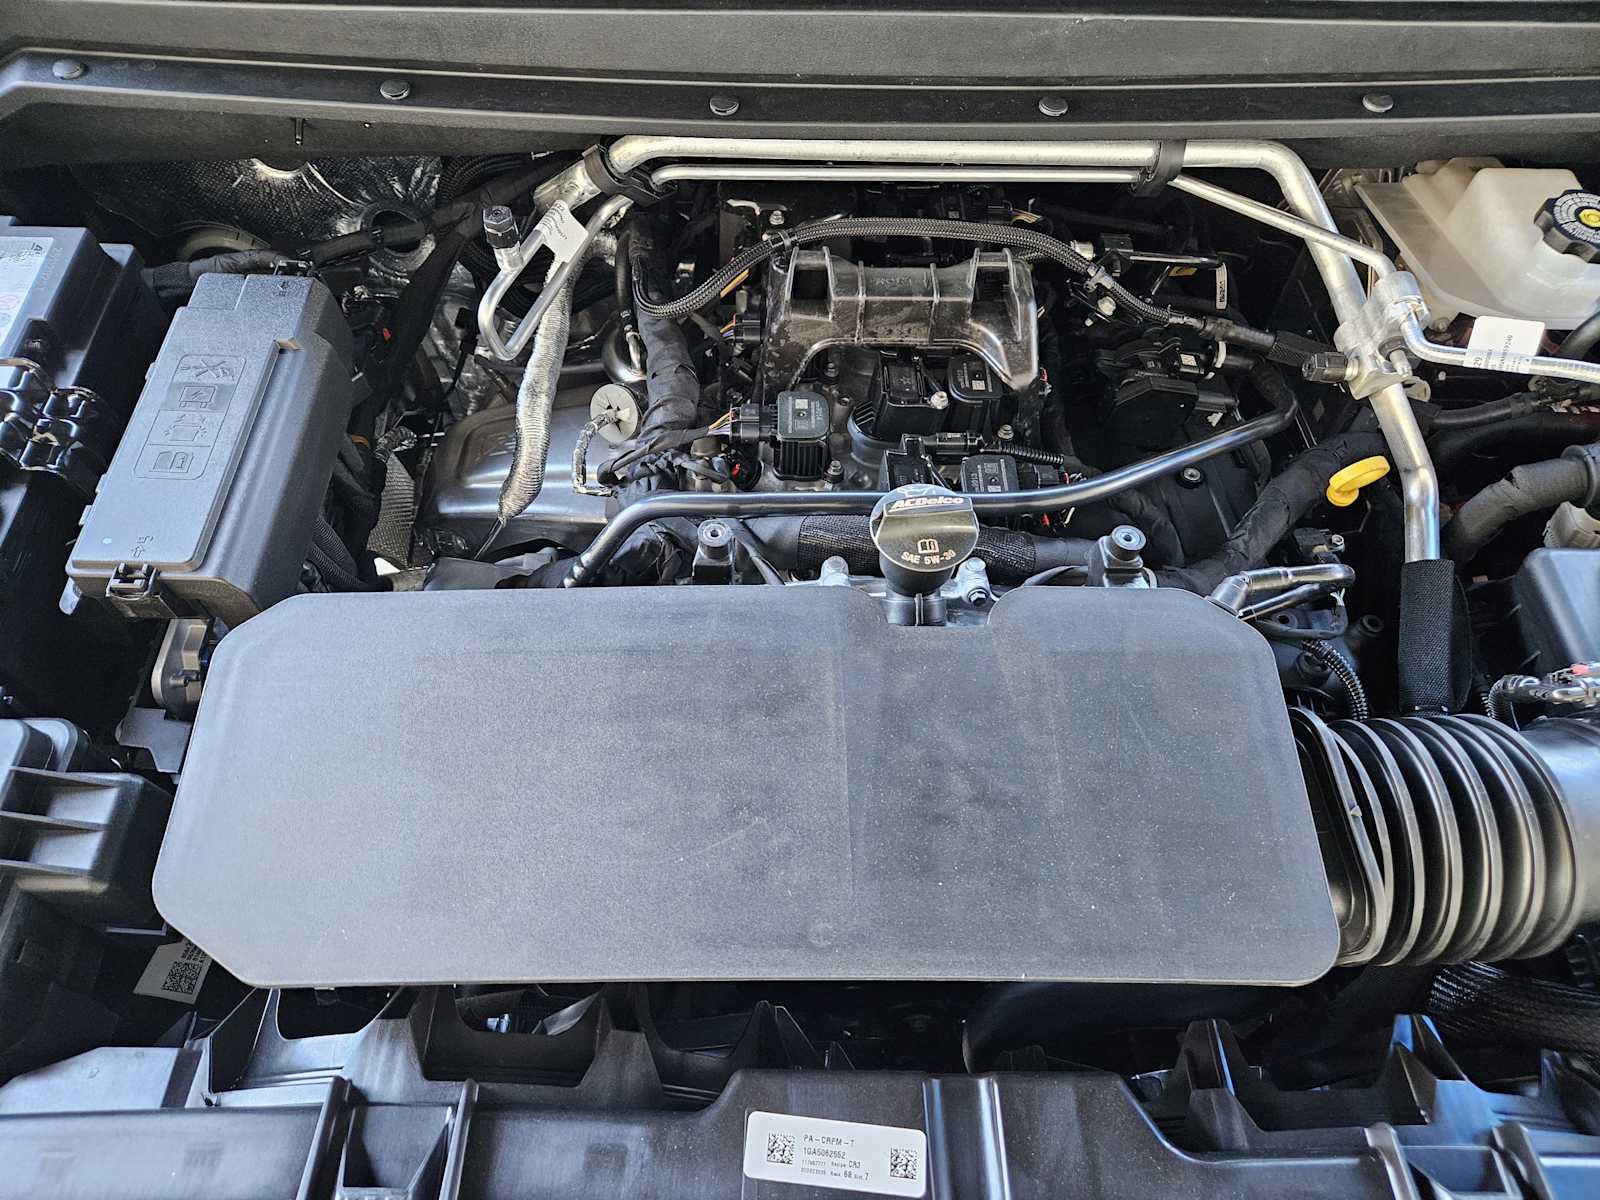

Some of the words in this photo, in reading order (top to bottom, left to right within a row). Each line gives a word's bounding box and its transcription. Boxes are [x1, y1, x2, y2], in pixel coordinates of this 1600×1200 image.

[890, 496, 964, 509] ACDelco
[901, 551, 921, 565] SAE
[924, 549, 957, 565] 5W-30
